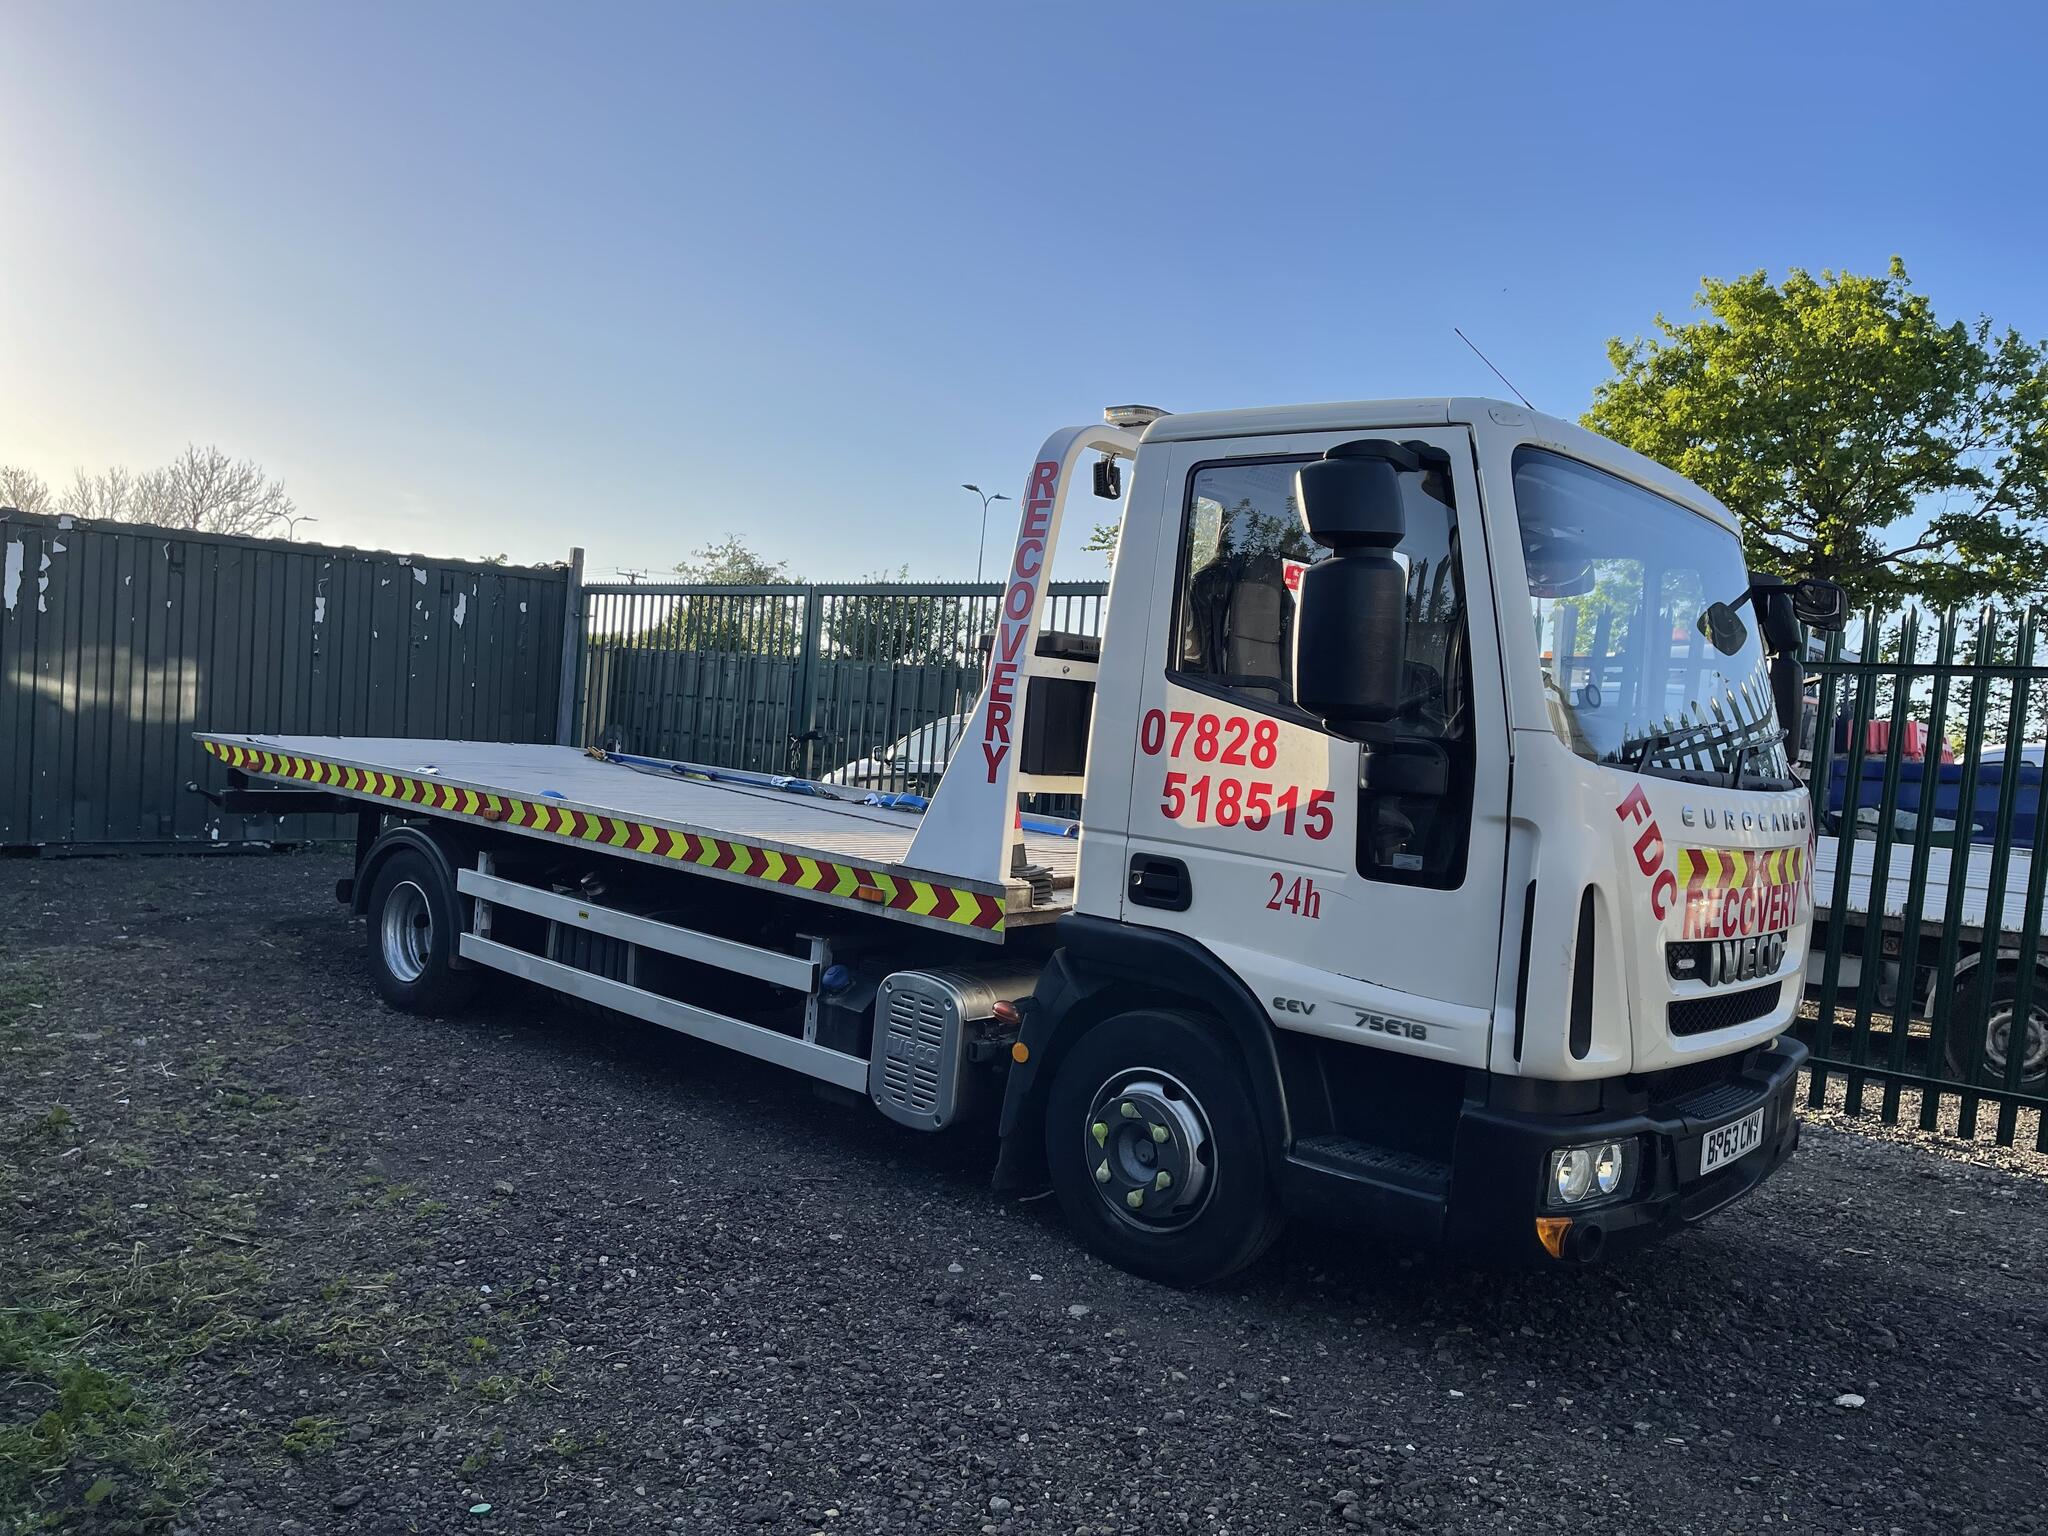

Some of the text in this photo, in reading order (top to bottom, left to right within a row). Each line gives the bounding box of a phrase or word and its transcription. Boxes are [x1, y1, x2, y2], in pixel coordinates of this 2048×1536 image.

[981, 461, 1059, 784] RECOVERY
[1141, 708, 1279, 769] 07828
[1160, 772, 1335, 840] 518515
[1616, 782, 1678, 922] FDC
[1266, 872, 1321, 919] 24h
[1682, 881, 1801, 940] RECOVERY
[1710, 933, 1785, 988] IVECO
[1272, 996, 1427, 1041] EEV 75E18
